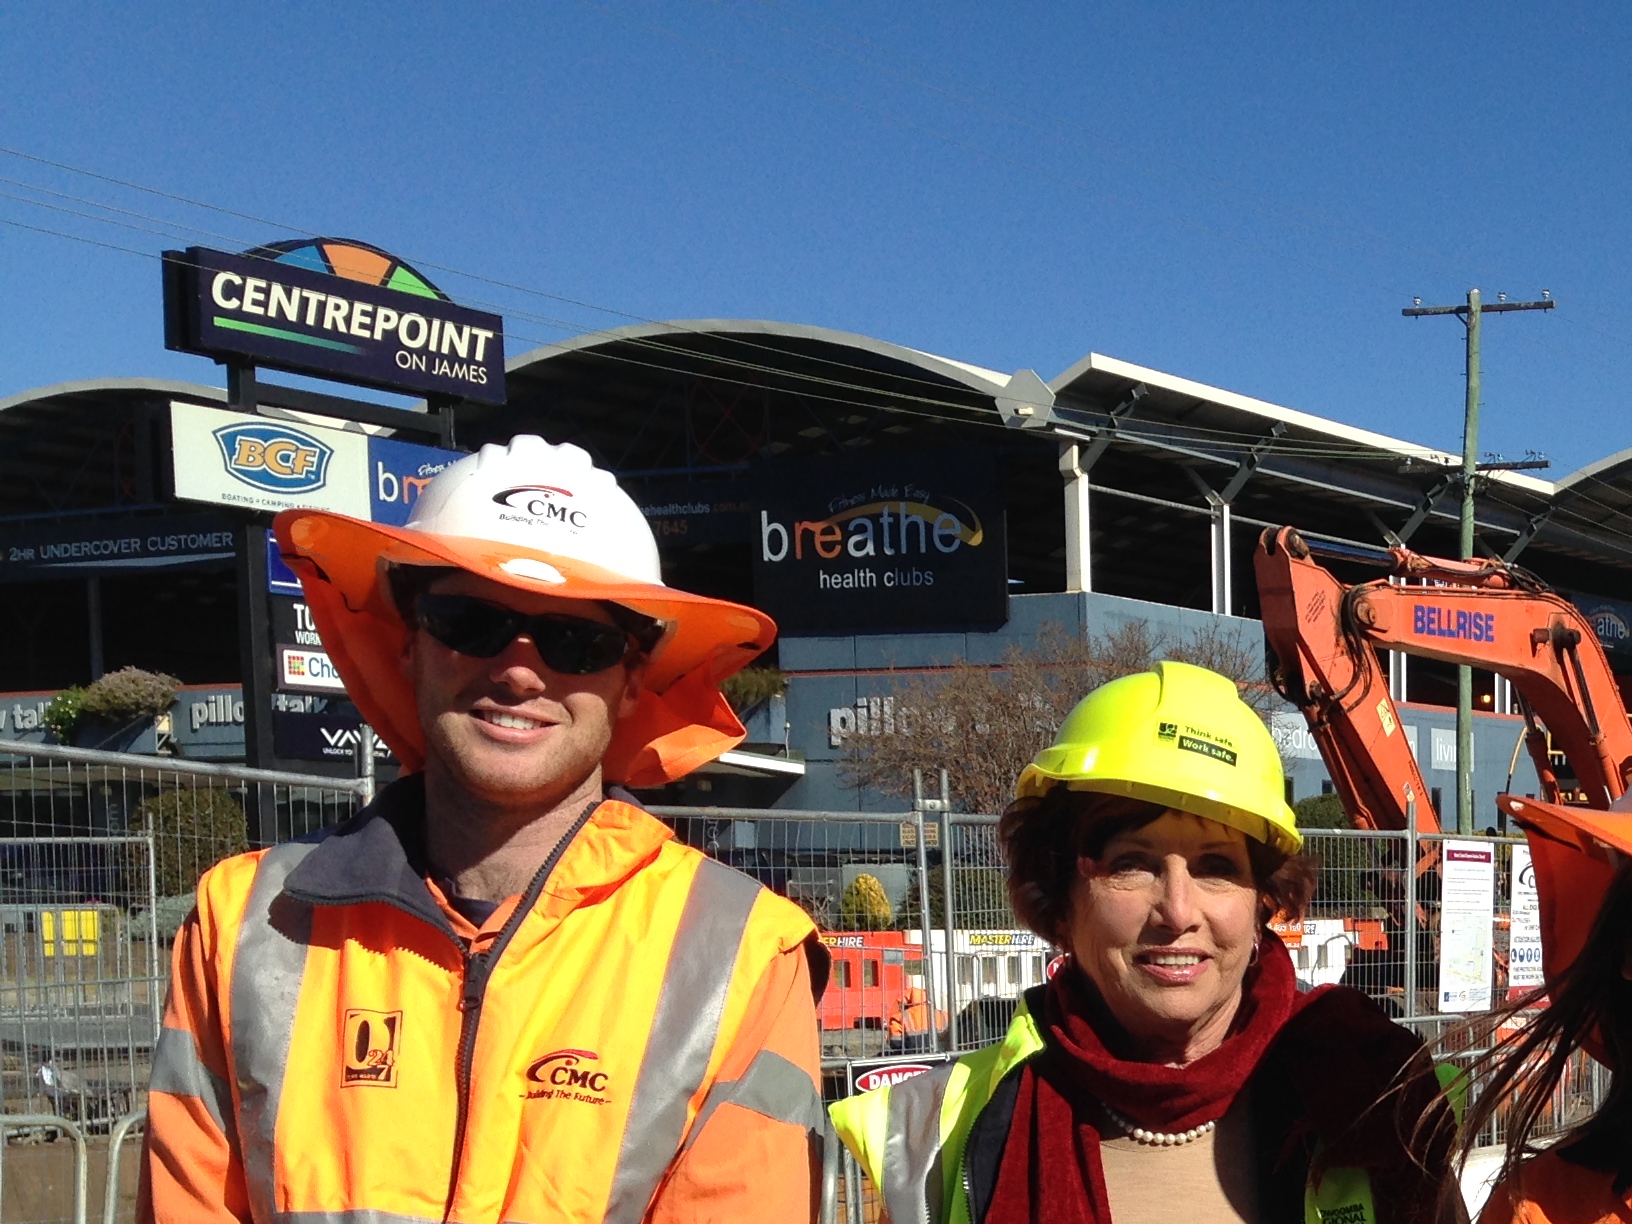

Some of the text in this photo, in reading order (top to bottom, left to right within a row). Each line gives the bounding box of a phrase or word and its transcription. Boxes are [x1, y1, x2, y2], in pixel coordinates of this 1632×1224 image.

[211, 270, 494, 362] CENTREPOINT
[395, 350, 488, 385] ON JAMES
[233, 438, 319, 477] BCF
[221, 492, 254, 504] BOATING
[527, 499, 588, 528] CMC
[761, 502, 962, 562] breathe
[9, 532, 233, 562] 2HR UNDERCOVER CUSTOMER
[819, 566, 934, 589] health clubs
[1413, 604, 1496, 643] BELLRISE
[191, 695, 245, 726] pillo
[1185, 726, 1212, 739] Think
[1182, 739, 1235, 763] Work safe.
[969, 934, 1036, 946] MASTERHIRE
[550, 1066, 609, 1092] CMC
[555, 1089, 572, 1100] The
[573, 1092, 605, 1106] Future
